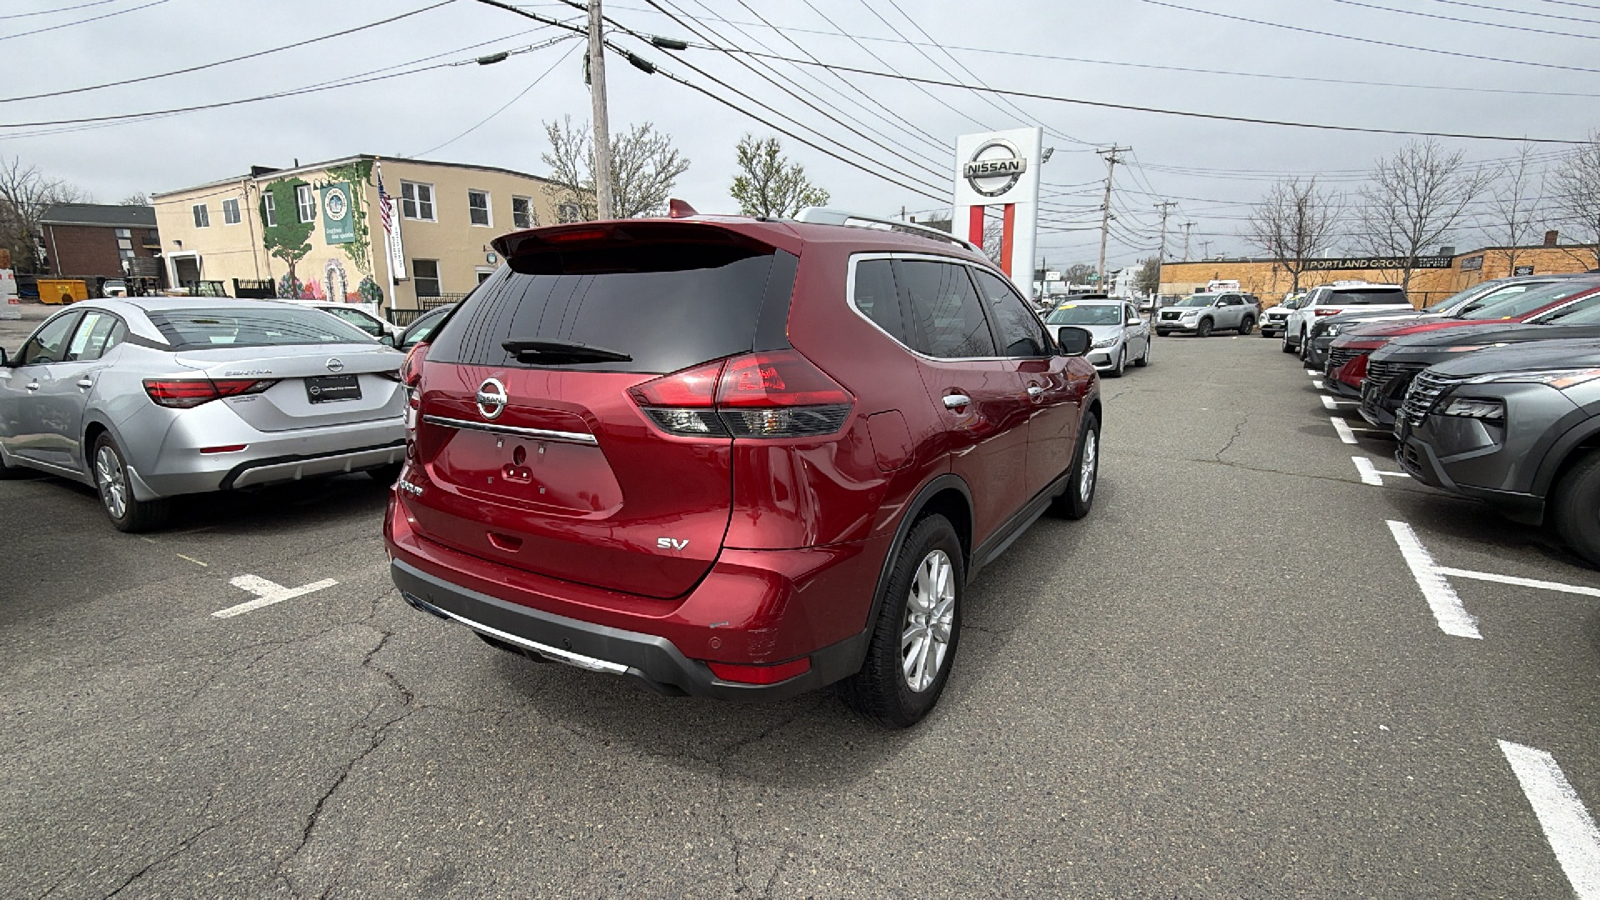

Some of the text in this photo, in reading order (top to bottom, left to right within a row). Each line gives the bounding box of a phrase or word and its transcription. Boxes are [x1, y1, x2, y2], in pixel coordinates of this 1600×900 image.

[968, 161, 1019, 174] NISSAN
[1309, 259, 1369, 269] PORTLAND
[657, 537, 690, 551] SV
